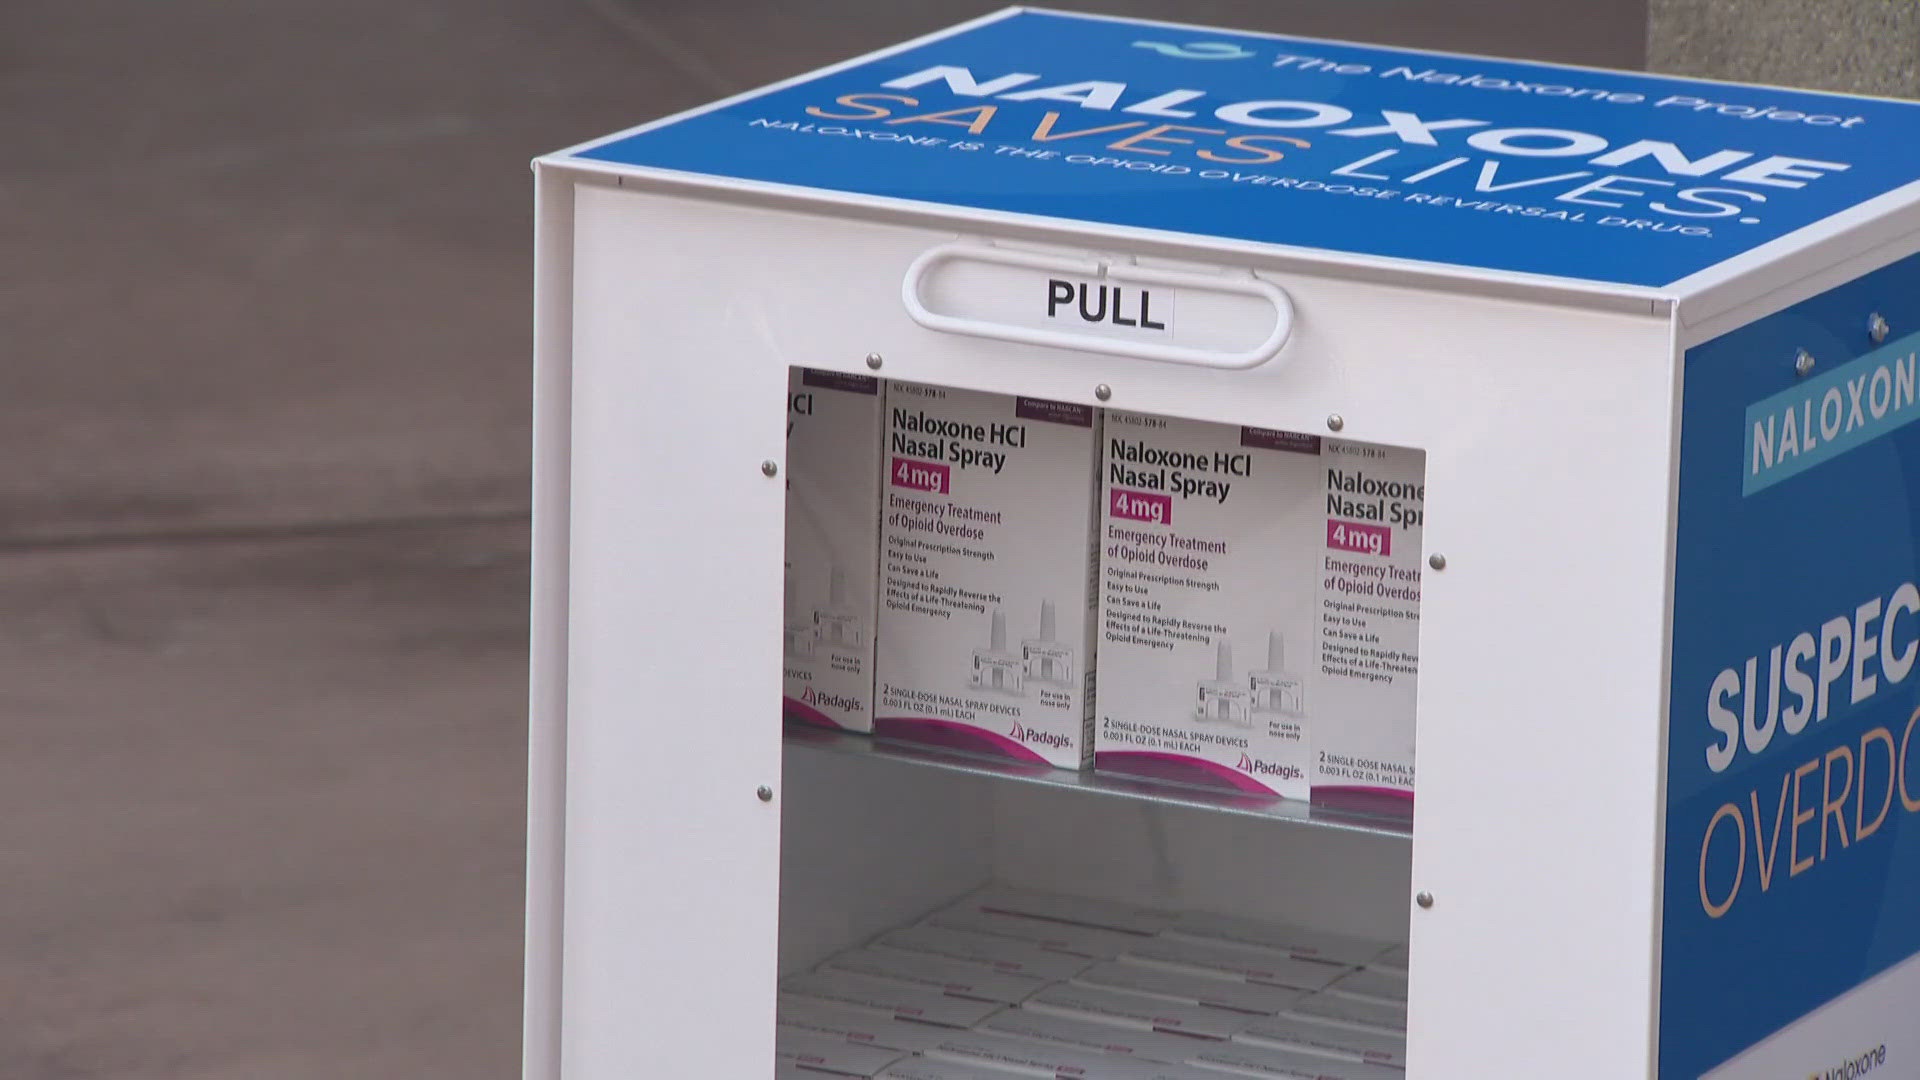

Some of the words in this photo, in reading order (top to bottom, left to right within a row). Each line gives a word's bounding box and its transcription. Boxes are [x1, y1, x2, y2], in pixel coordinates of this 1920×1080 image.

[1273, 54, 1371, 76] The
[1380, 64, 1646, 104] Naloxone
[1655, 95, 1865, 129] Project
[880, 65, 1853, 189] NALOXONE
[749, 118, 947, 147] NALOXONE
[949, 141, 985, 151] IS
[995, 145, 1061, 160] THE
[1064, 155, 1191, 176] OPIOID
[1199, 170, 1402, 202] OVERDOSE
[1403, 192, 1585, 223] REVERSAL
[805, 94, 1312, 166] SAVES
[1331, 149, 1767, 224] LIVES.
[1048, 279, 1165, 330] PULL
[892, 407, 985, 442] Naloxone
[891, 431, 945, 461] Nasal
[949, 440, 1006, 475] Spray
[1110, 438, 1209, 472] Naloxone
[1110, 462, 1165, 491] Nasal
[1170, 471, 1230, 505] Spray
[1327, 468, 1424, 502] Naloxone
[889, 493, 945, 519] Emergency
[948, 503, 1001, 525] Treatment
[1326, 492, 1384, 523] Nasal
[889, 513, 899, 528] of
[901, 514, 934, 533] Opioid
[936, 520, 984, 541] Overdose
[1108, 524, 1167, 549] Emergency
[1169, 533, 1226, 555] Treatment
[888, 535, 917, 549] Original
[918, 540, 961, 556] Prescription
[962, 547, 995, 563] Strength
[888, 549, 904, 563] Easy
[905, 551, 913, 562] to
[914, 553, 927, 564] Use
[1107, 544, 1118, 558] of
[1120, 545, 1155, 564] Opioid
[1158, 550, 1208, 571] Overdose
[887, 562, 901, 574] Can
[902, 564, 919, 577] Save
[925, 569, 939, 580] Life
[1107, 567, 1137, 580] Original
[1139, 571, 1184, 587] Prescription
[1186, 578, 1219, 593] Strength
[1325, 555, 1386, 581] Emergency
[886, 576, 920, 591] Designed
[921, 582, 929, 592] to
[930, 583, 958, 598] Rapidly
[959, 587, 987, 602] Reverse
[988, 592, 1001, 604] the
[886, 587, 910, 601] Effects
[911, 591, 919, 602] of
[1107, 581, 1124, 594] Easy
[1125, 584, 1133, 593] to
[1135, 585, 1148, 595] Use
[1324, 575, 1335, 590] of
[1337, 576, 1374, 596] Opioid
[886, 599, 910, 613] Opioid
[911, 602, 951, 620] Emergency
[1106, 595, 1121, 605] Can
[1122, 596, 1140, 609] Save
[1147, 601, 1161, 611] Life
[1323, 599, 1355, 613] Original
[1356, 604, 1404, 619] Prescription
[1105, 620, 1130, 634] Effects
[1132, 624, 1140, 634] of
[1106, 608, 1141, 623] Designed
[1142, 614, 1151, 624] to
[1152, 615, 1181, 629] Rapidly
[1182, 619, 1212, 633] Reverse
[1214, 624, 1227, 635] the
[1323, 613, 1342, 627] Easy
[1342, 616, 1351, 626] to
[1352, 617, 1366, 628] Use
[1105, 631, 1131, 645] Opioid
[1132, 635, 1174, 651] Emergency
[1322, 627, 1338, 638] Can
[1339, 629, 1357, 641] Save
[1365, 633, 1380, 644] Life
[1322, 641, 1359, 656] Designed
[1360, 646, 1369, 657] to
[1370, 647, 1400, 663] Rapidly
[1322, 652, 1348, 666] Effects
[1321, 664, 1348, 678] Opioid
[1349, 667, 1393, 684] Emergency
[883, 683, 889, 696] 2
[939, 694, 964, 709] NASAL
[965, 699, 989, 714] SPRAY
[989, 703, 1021, 718] DEVICES
[903, 699, 912, 711] FL
[913, 700, 925, 713] OZ
[955, 707, 976, 721] EACH
[1103, 717, 1110, 729] 2
[1162, 727, 1188, 743] NASAL
[1190, 732, 1215, 747] SPRAY
[1215, 735, 1249, 749] DEVICES
[1269, 720, 1280, 730] For
[1125, 733, 1134, 745] FL
[1135, 734, 1147, 747] OZ
[1179, 742, 1201, 754] EACH
[1319, 751, 1326, 763] 2
[1380, 762, 1408, 775] NASAL
[1341, 767, 1351, 779] FL
[1352, 769, 1365, 781] OZ
